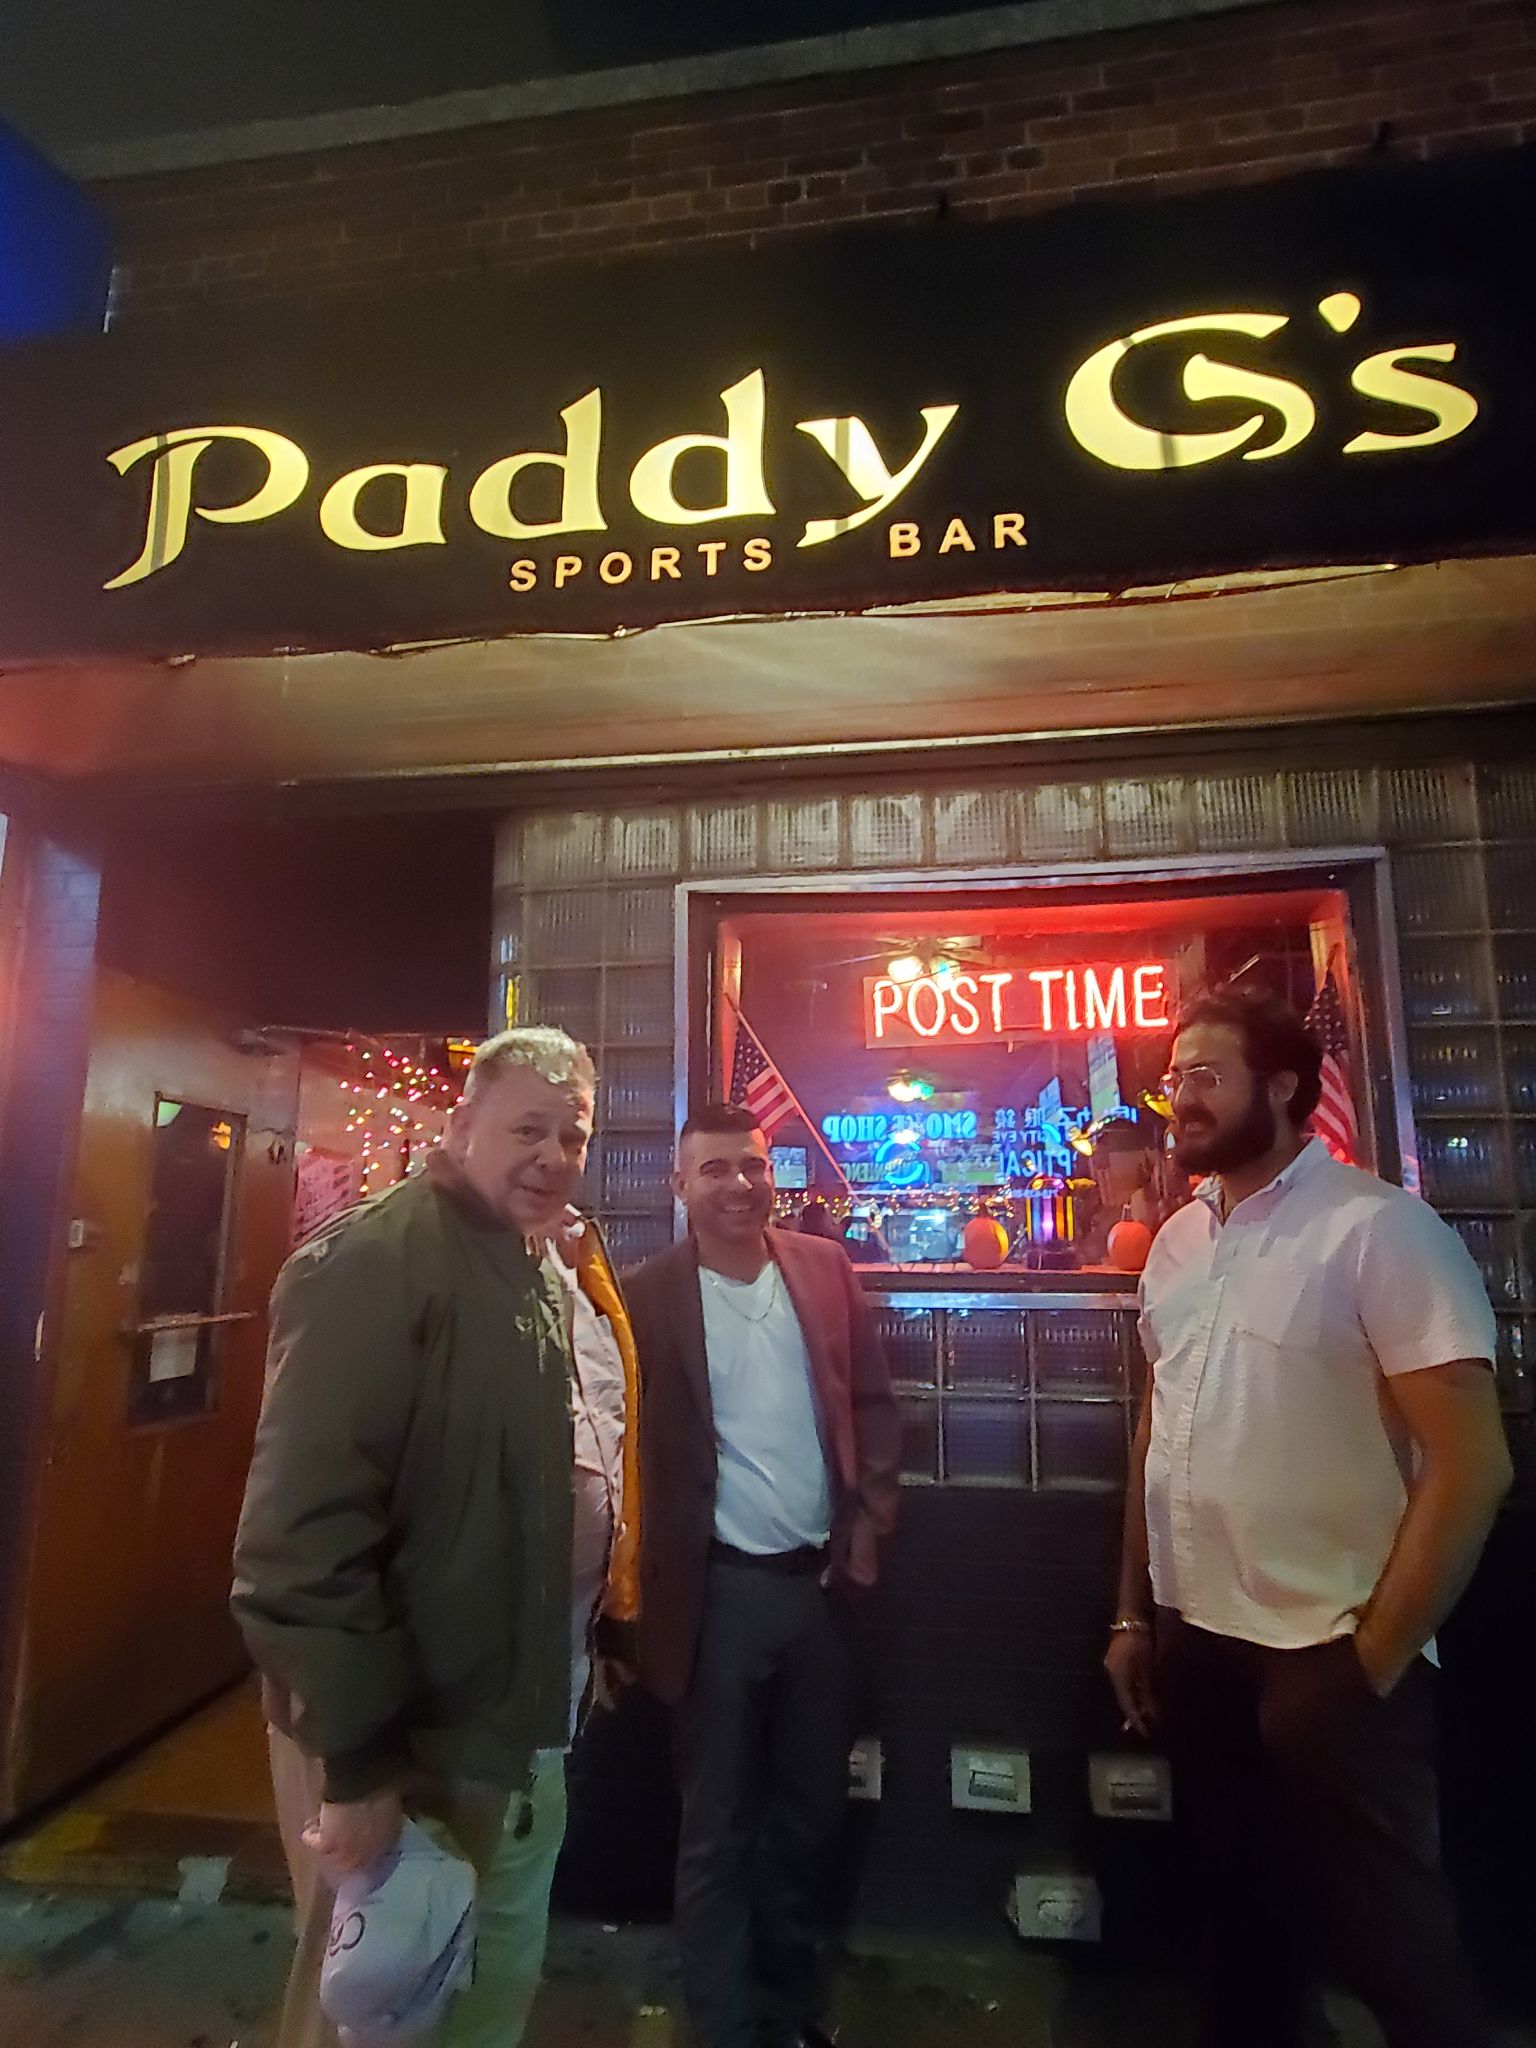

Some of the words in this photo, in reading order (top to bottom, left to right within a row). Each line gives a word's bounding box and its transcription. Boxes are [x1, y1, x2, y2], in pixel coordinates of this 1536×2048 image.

[103, 368, 960, 590] Paddy
[1065, 292, 1479, 471] G's
[509, 538, 773, 593] SPORTS
[889, 513, 1028, 558] BAR
[873, 973, 1013, 1038] POST
[1029, 965, 1169, 1031] TIME
